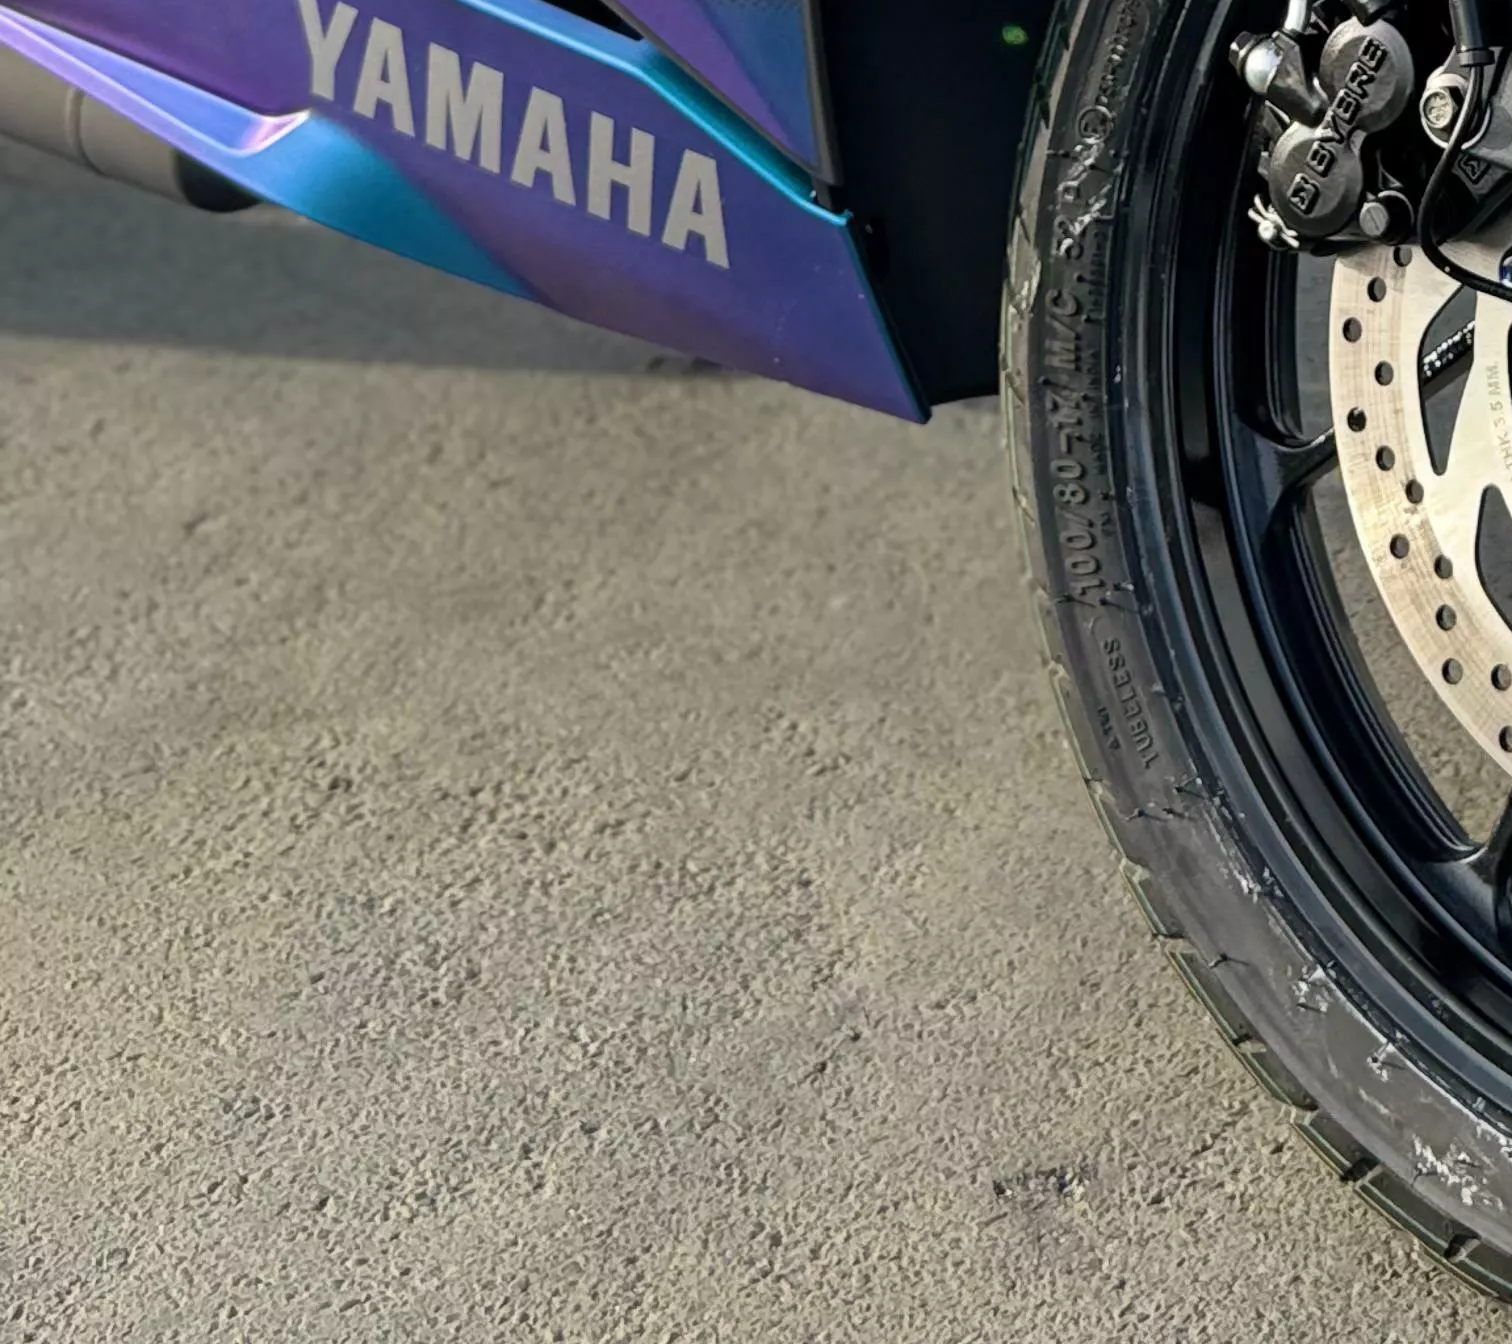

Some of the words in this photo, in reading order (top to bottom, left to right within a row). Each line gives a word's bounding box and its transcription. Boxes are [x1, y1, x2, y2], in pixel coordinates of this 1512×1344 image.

[1306, 37, 1387, 176] BYBRE
[1489, 399, 1506, 427] 3.5
[1104, 638, 1159, 769] TUBELESS
